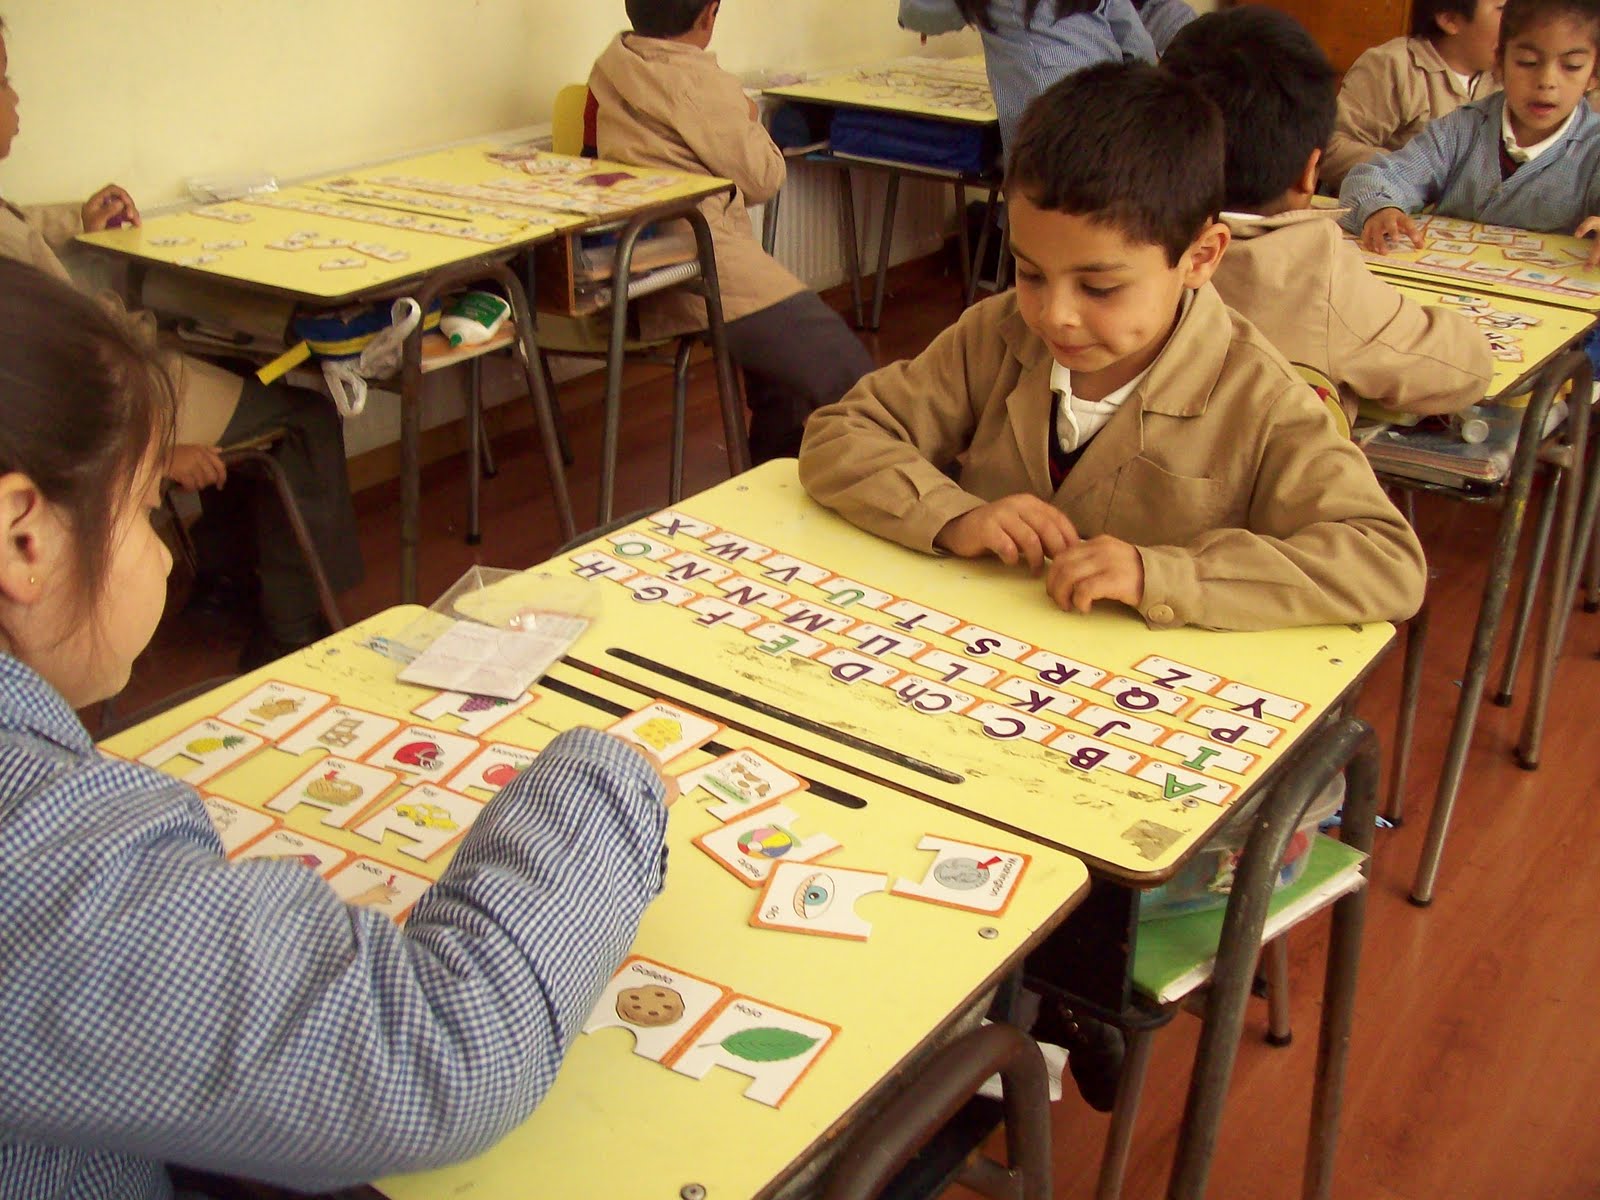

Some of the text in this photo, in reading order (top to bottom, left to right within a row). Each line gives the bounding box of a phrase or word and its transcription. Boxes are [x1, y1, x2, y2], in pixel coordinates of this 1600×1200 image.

[614, 541, 652, 557] O
[665, 561, 712, 581] Ñ
[724, 585, 767, 606] N
[654, 518, 1250, 744] P Q R S T U V W X
[782, 609, 835, 632] M
[575, 560, 1207, 800] A B C Ch D E F G H
[941, 662, 968, 682] L
[1010, 689, 1055, 713] K
[1152, 668, 1267, 719] Y Z
[1093, 720, 1131, 738] J
[1182, 746, 1222, 771] I
[765, 905, 779, 920] Ojo
[631, 963, 673, 984] Galleta
[733, 1002, 762, 1018] Hoja
